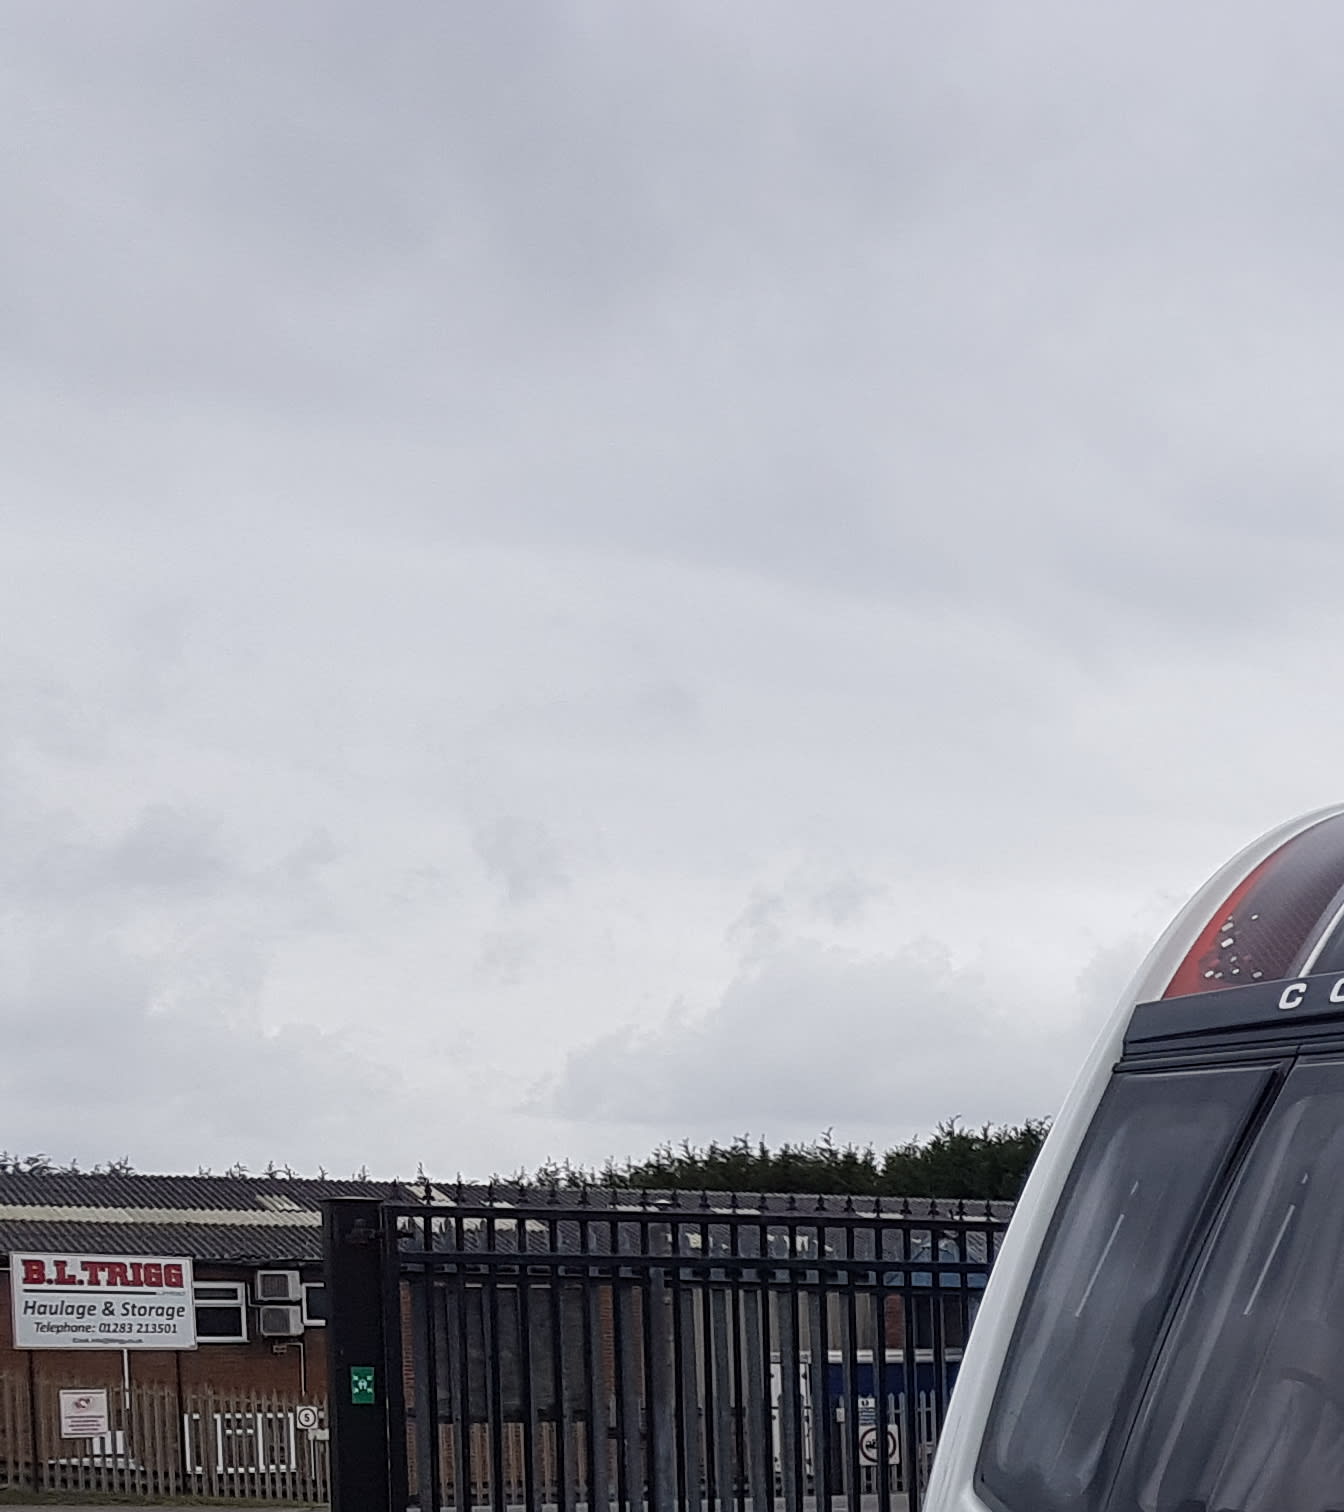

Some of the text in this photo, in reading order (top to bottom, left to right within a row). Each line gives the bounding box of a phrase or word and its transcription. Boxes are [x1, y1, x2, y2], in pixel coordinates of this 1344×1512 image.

[21, 1259, 185, 1288] B.L.TRIGG
[23, 1301, 186, 1320] Haulage & Storage
[34, 1322, 178, 1335] Telephone: 01283 213501
